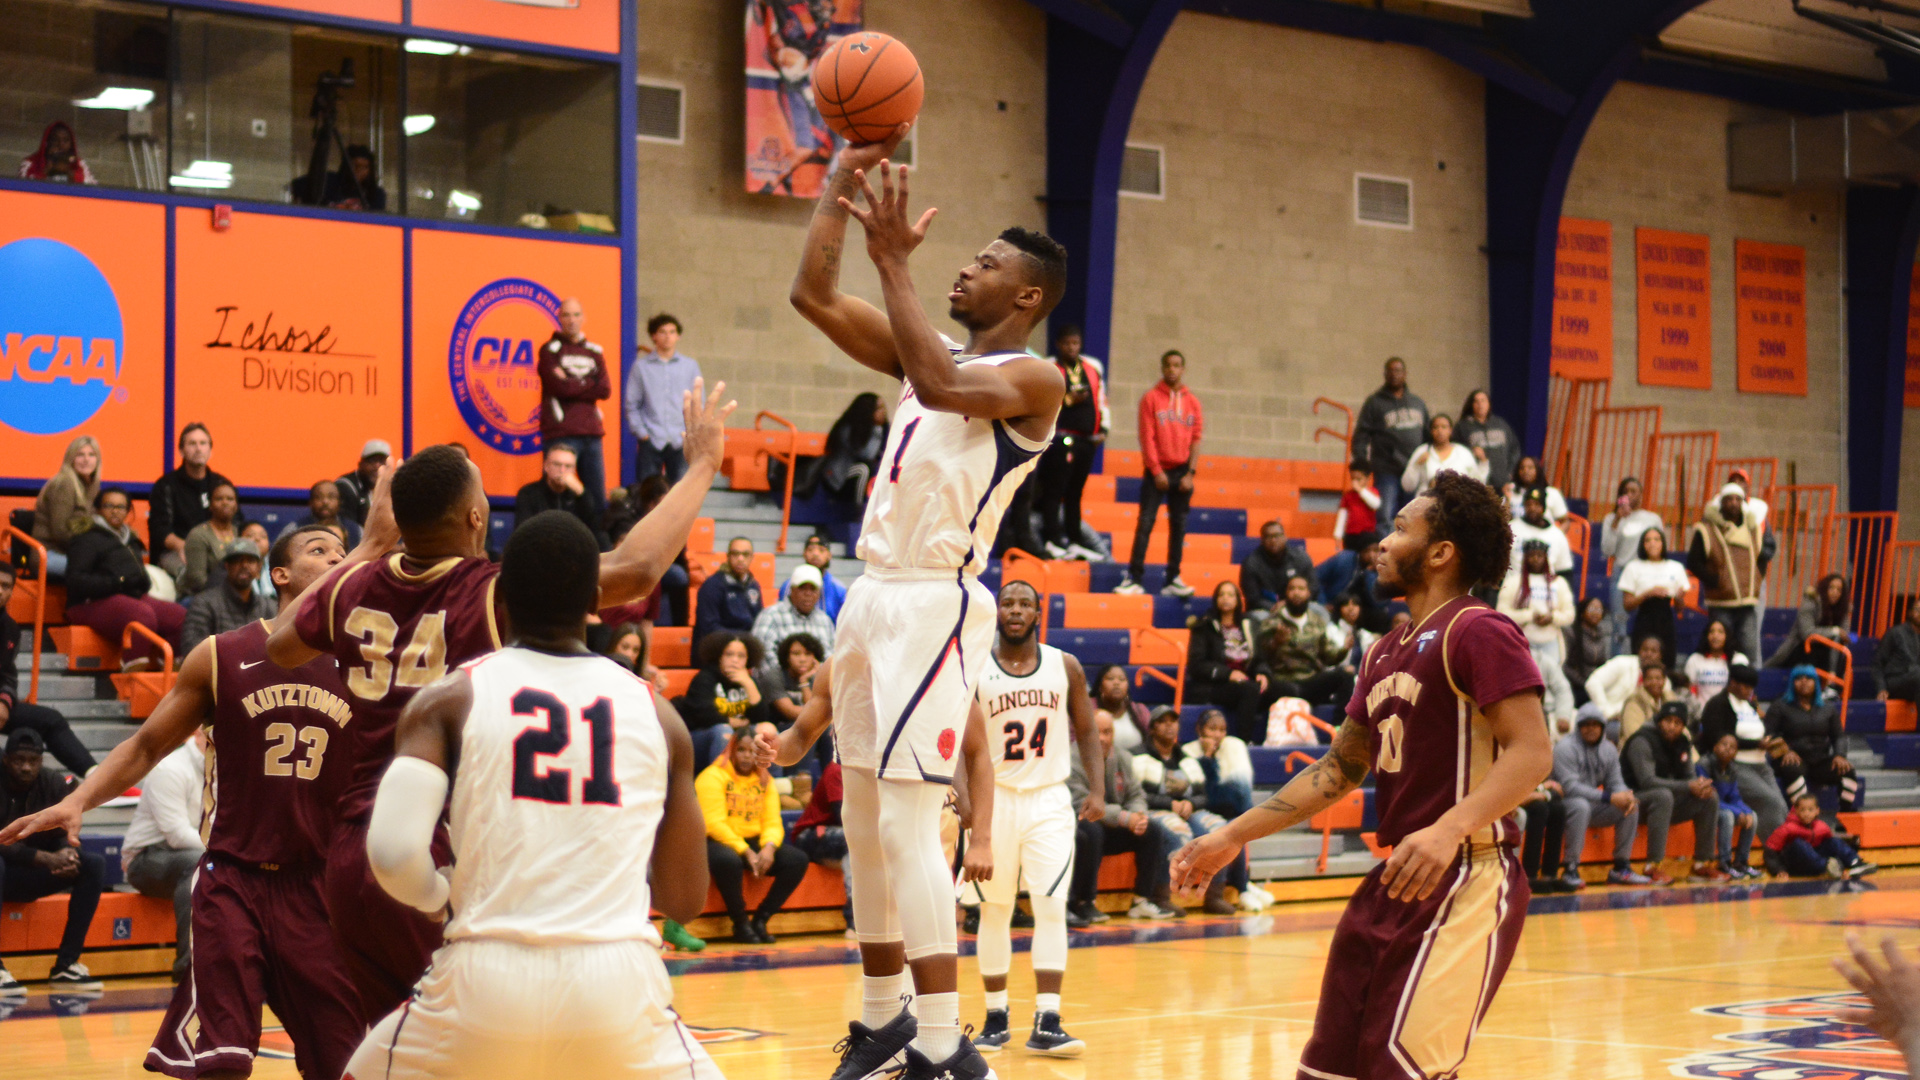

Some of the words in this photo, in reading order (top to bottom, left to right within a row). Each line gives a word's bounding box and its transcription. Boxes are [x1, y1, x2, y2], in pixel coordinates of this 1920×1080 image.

[203, 305, 238, 349] I
[241, 311, 338, 355] chose
[454, 328, 469, 376] CENTRAL
[464, 284, 534, 325] INTERCOLLEGIATE
[536, 291, 560, 317] ATHLE
[1559, 315, 1590, 335] 1999
[1661, 326, 1690, 347] 1999
[243, 357, 353, 394] Division
[366, 365, 377, 396] II
[472, 336, 540, 375] CIA
[890, 416, 922, 483] 1
[344, 606, 449, 701] 34
[242, 683, 353, 729] KUTZTOWN
[988, 689, 1060, 718] LINCOLN
[264, 722, 329, 780] 23
[510, 686, 624, 808] 21
[1003, 716, 1048, 761] 24
